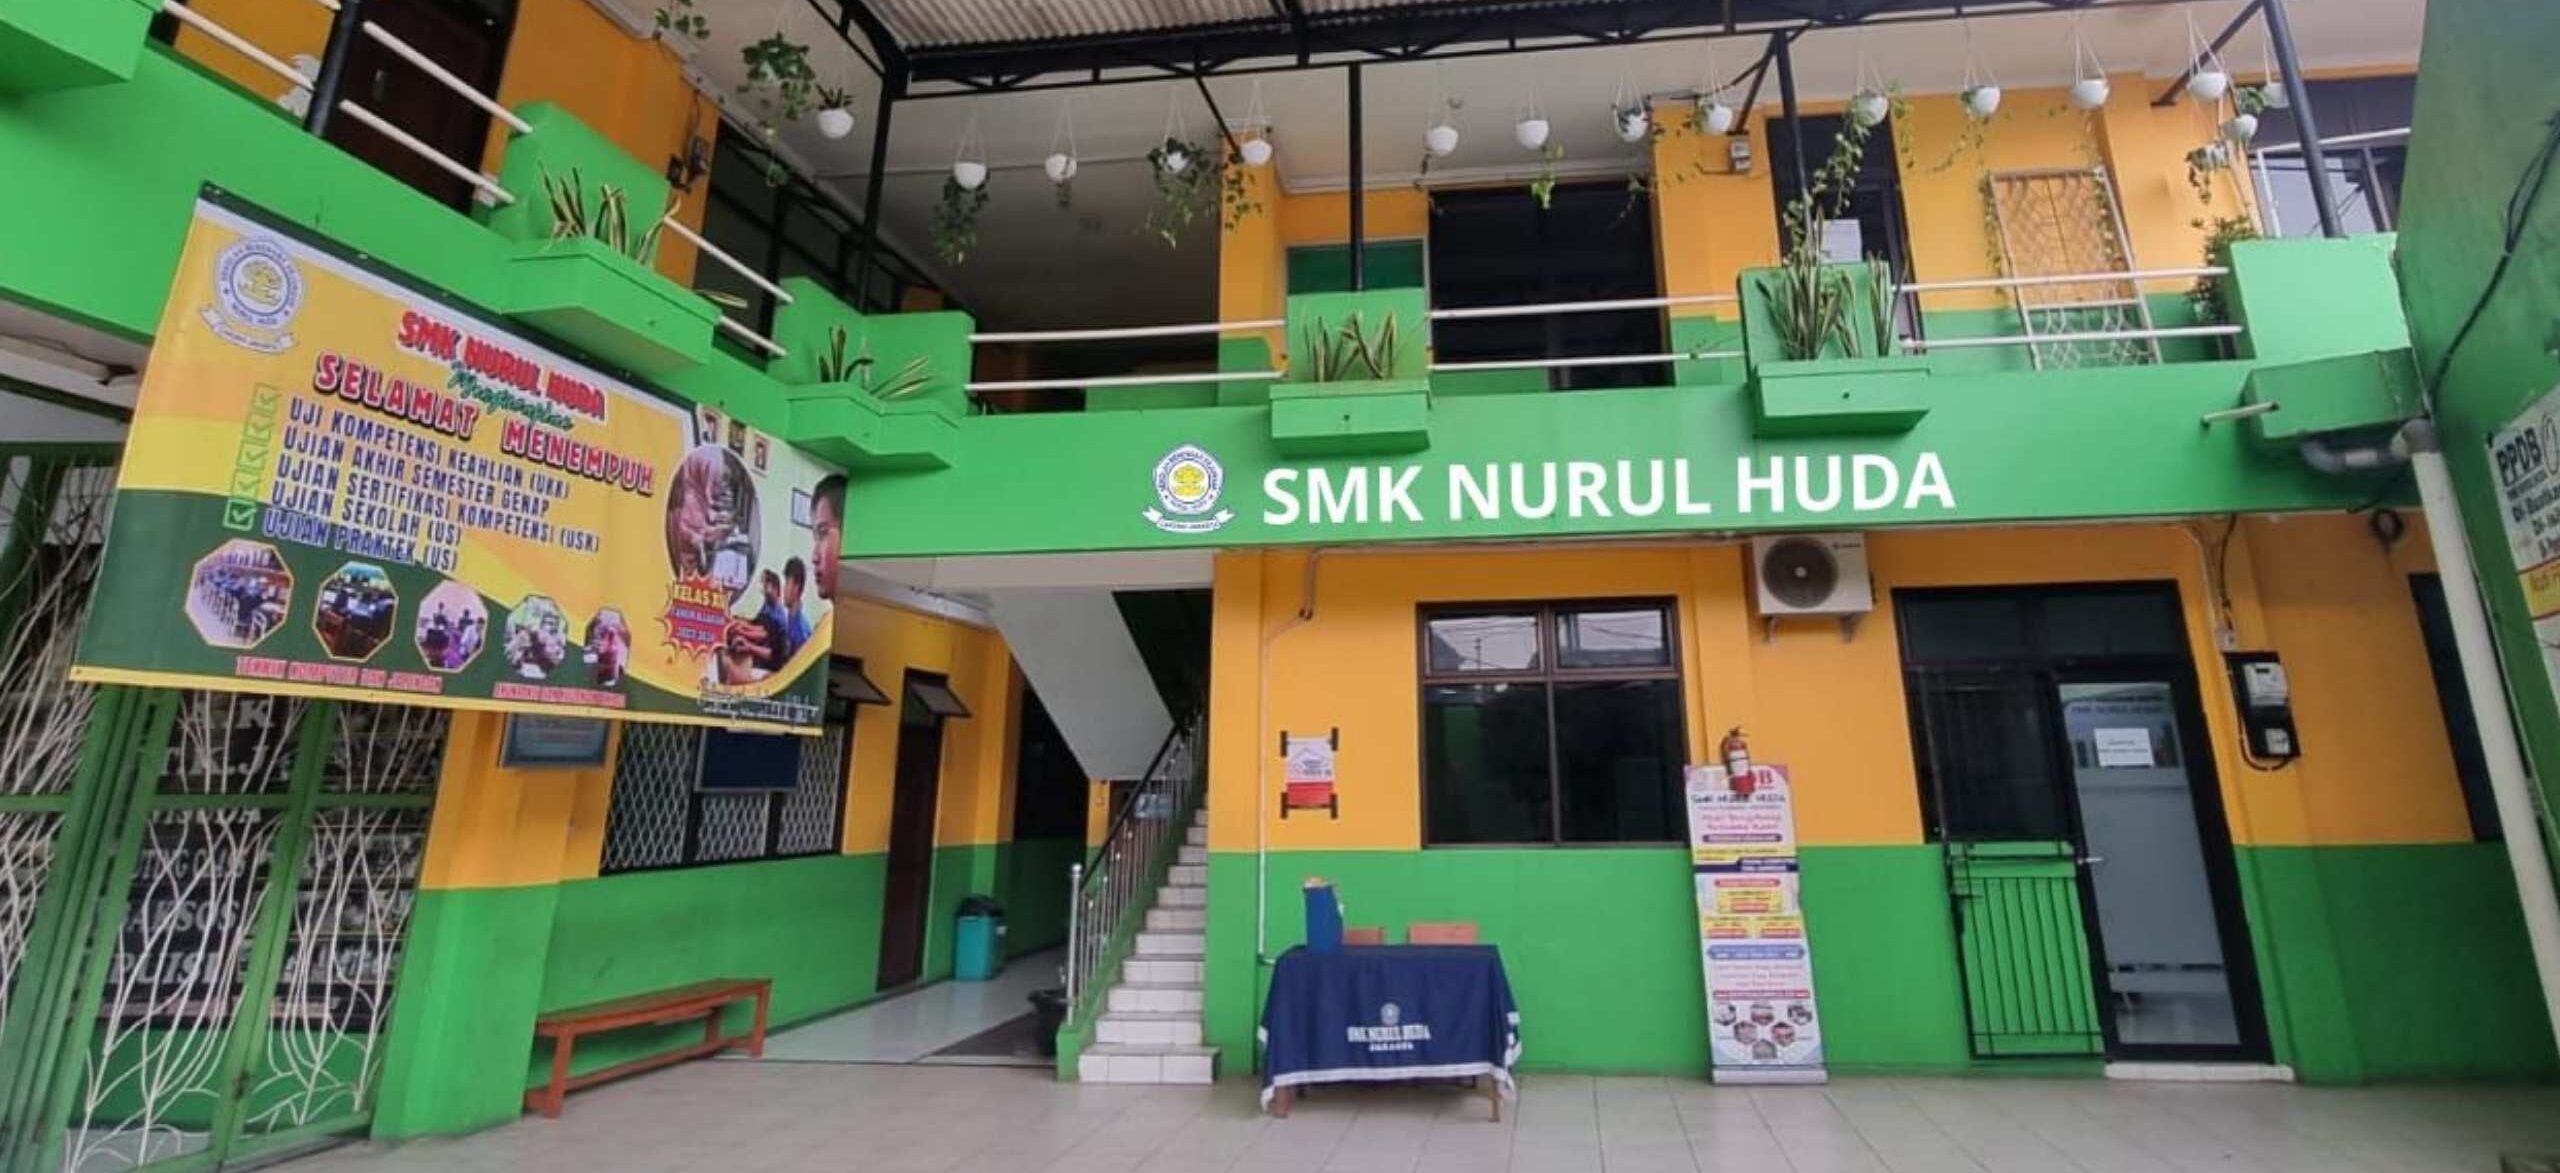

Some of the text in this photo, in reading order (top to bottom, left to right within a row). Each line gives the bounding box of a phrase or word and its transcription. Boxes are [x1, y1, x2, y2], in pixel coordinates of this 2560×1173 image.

[398, 310, 606, 421] SMK NURUL HUDA
[290, 397, 322, 426] UJI
[331, 409, 441, 460] KOMPETENSI
[449, 452, 523, 487] KEAHLIAN
[315, 353, 655, 496] SELAMAT MENEMPUH
[2497, 427, 2542, 488] PPDB
[277, 453, 340, 490] UJIAN
[347, 472, 450, 519] SERTIFIKASI
[456, 503, 554, 543] KOMPETENSI
[284, 427, 550, 517] UJIAN AKHIR SEMESTER GENAP
[1263, 465, 1423, 524] SMK
[1448, 458, 1711, 520] NURUL
[1737, 451, 1955, 512] HUDA
[264, 507, 458, 572] UJIAN PRAKTEK (US)
[271, 480, 462, 546] UJIAN SEKOLAH (US)
[673, 583, 711, 607] KELAS
